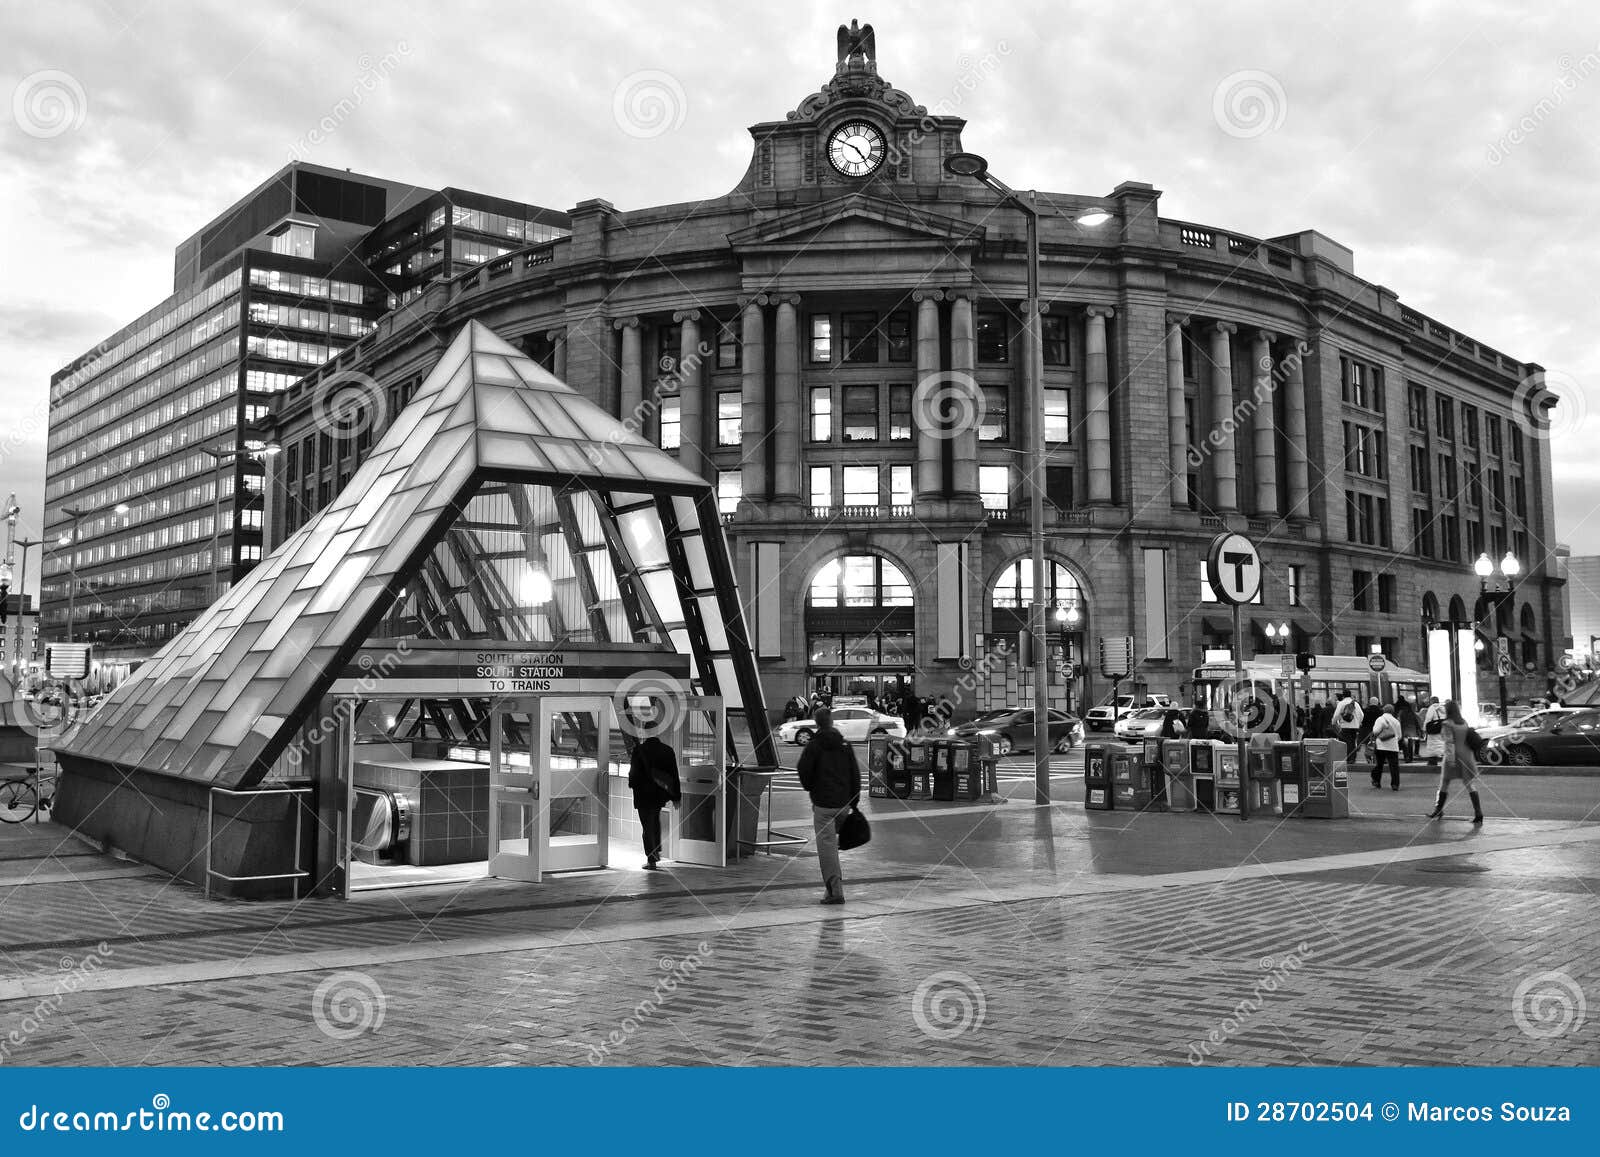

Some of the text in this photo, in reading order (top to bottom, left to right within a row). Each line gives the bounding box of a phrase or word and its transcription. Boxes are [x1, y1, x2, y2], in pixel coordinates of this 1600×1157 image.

[1224, 552, 1253, 593] T
[477, 653, 564, 664] SOUTH STATION
[477, 666, 564, 677] SOUTH STATION
[490, 680, 551, 690] TO TRAINS
